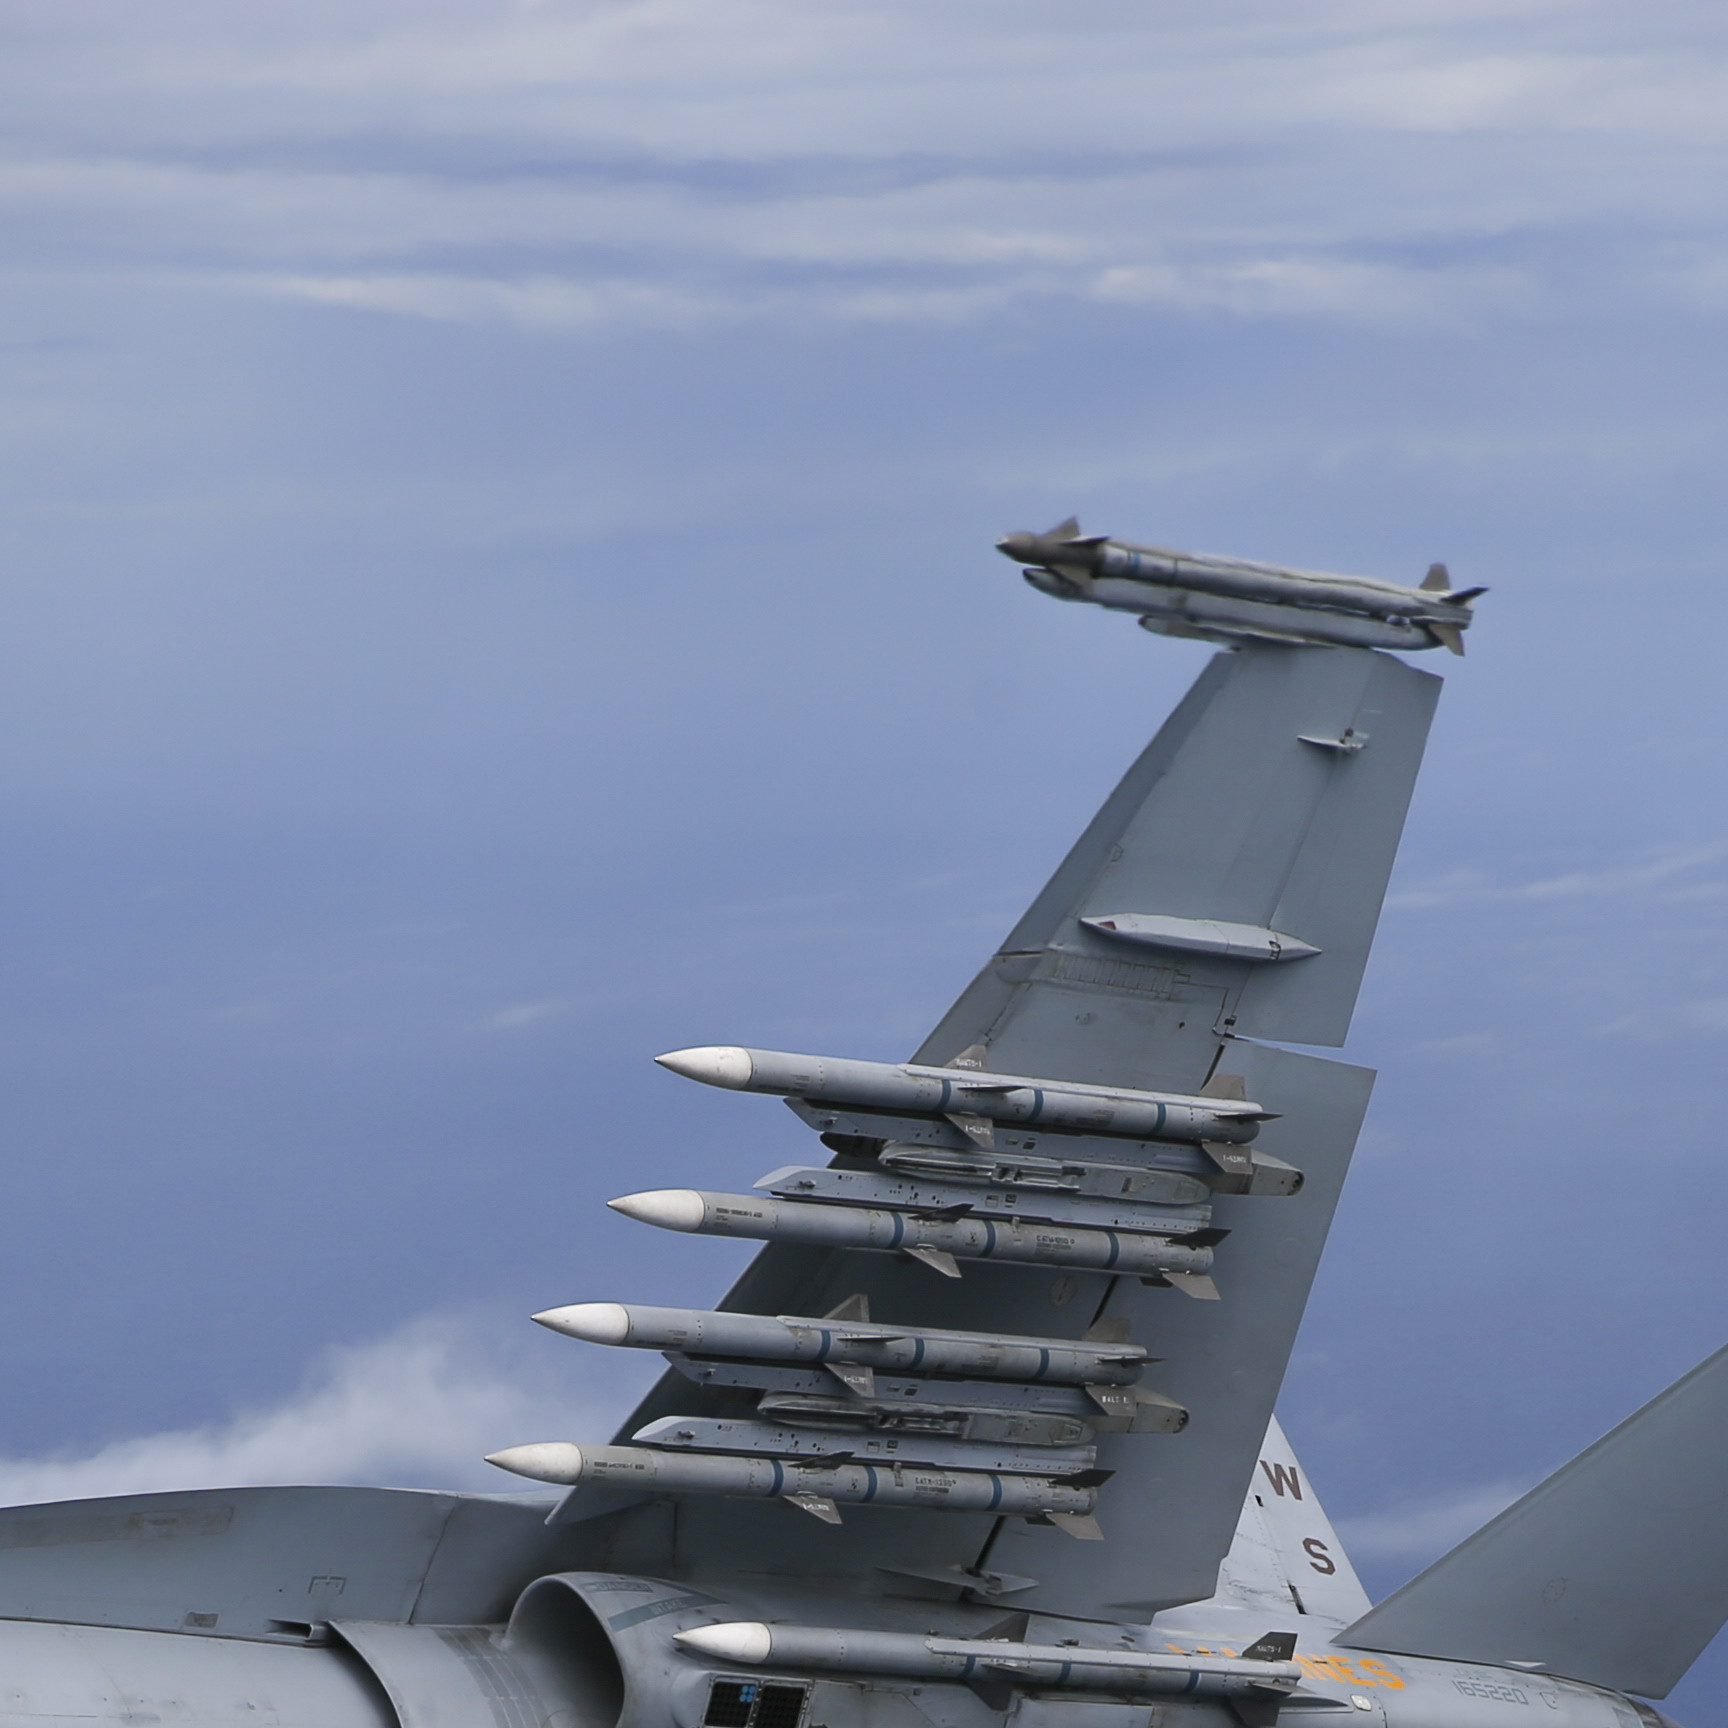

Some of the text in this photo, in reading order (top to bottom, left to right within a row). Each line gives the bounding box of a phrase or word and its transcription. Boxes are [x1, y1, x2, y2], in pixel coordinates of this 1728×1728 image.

[1259, 1460, 1303, 1501] W
[1302, 1537, 1336, 1576] S
[1451, 1680, 1529, 1705] 165220
